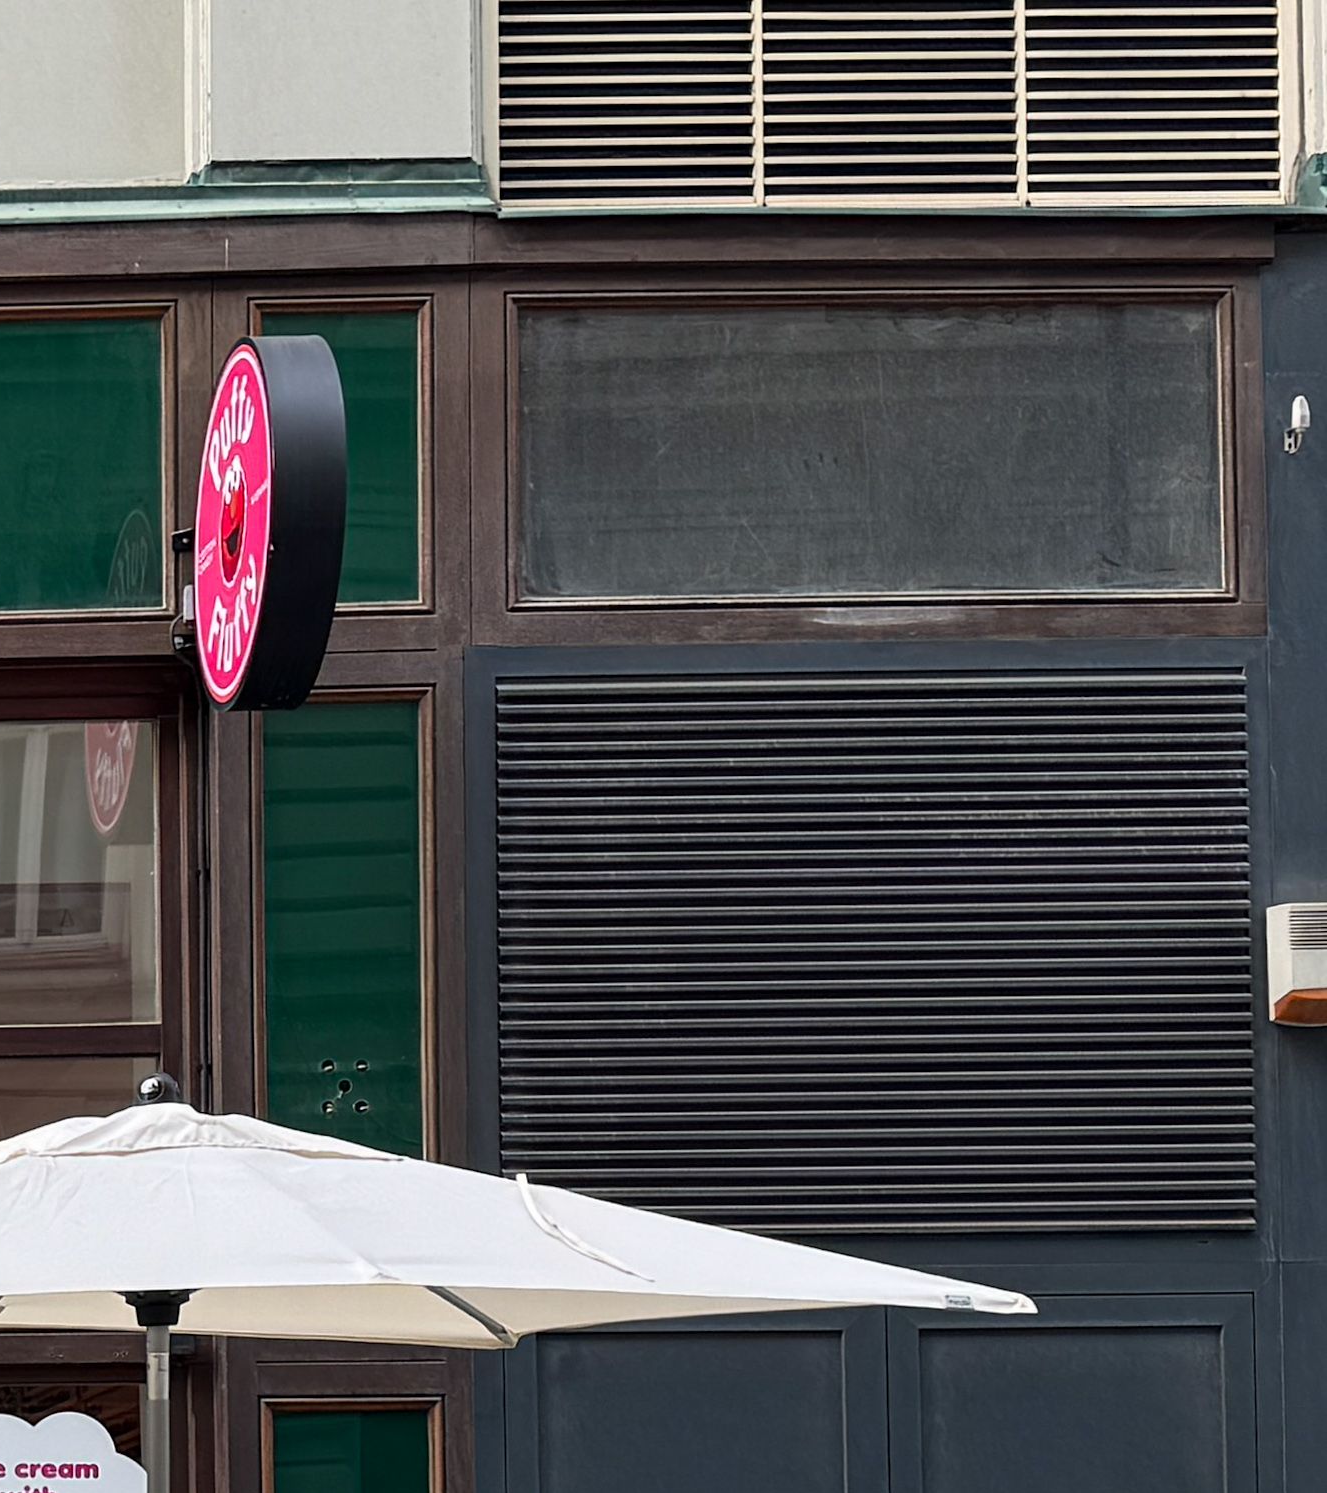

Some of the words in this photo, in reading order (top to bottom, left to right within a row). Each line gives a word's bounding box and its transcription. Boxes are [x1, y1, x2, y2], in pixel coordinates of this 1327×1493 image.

[208, 374, 256, 492] Puffy
[207, 554, 257, 672] Fluffy
[14, 1459, 99, 1479] cream
